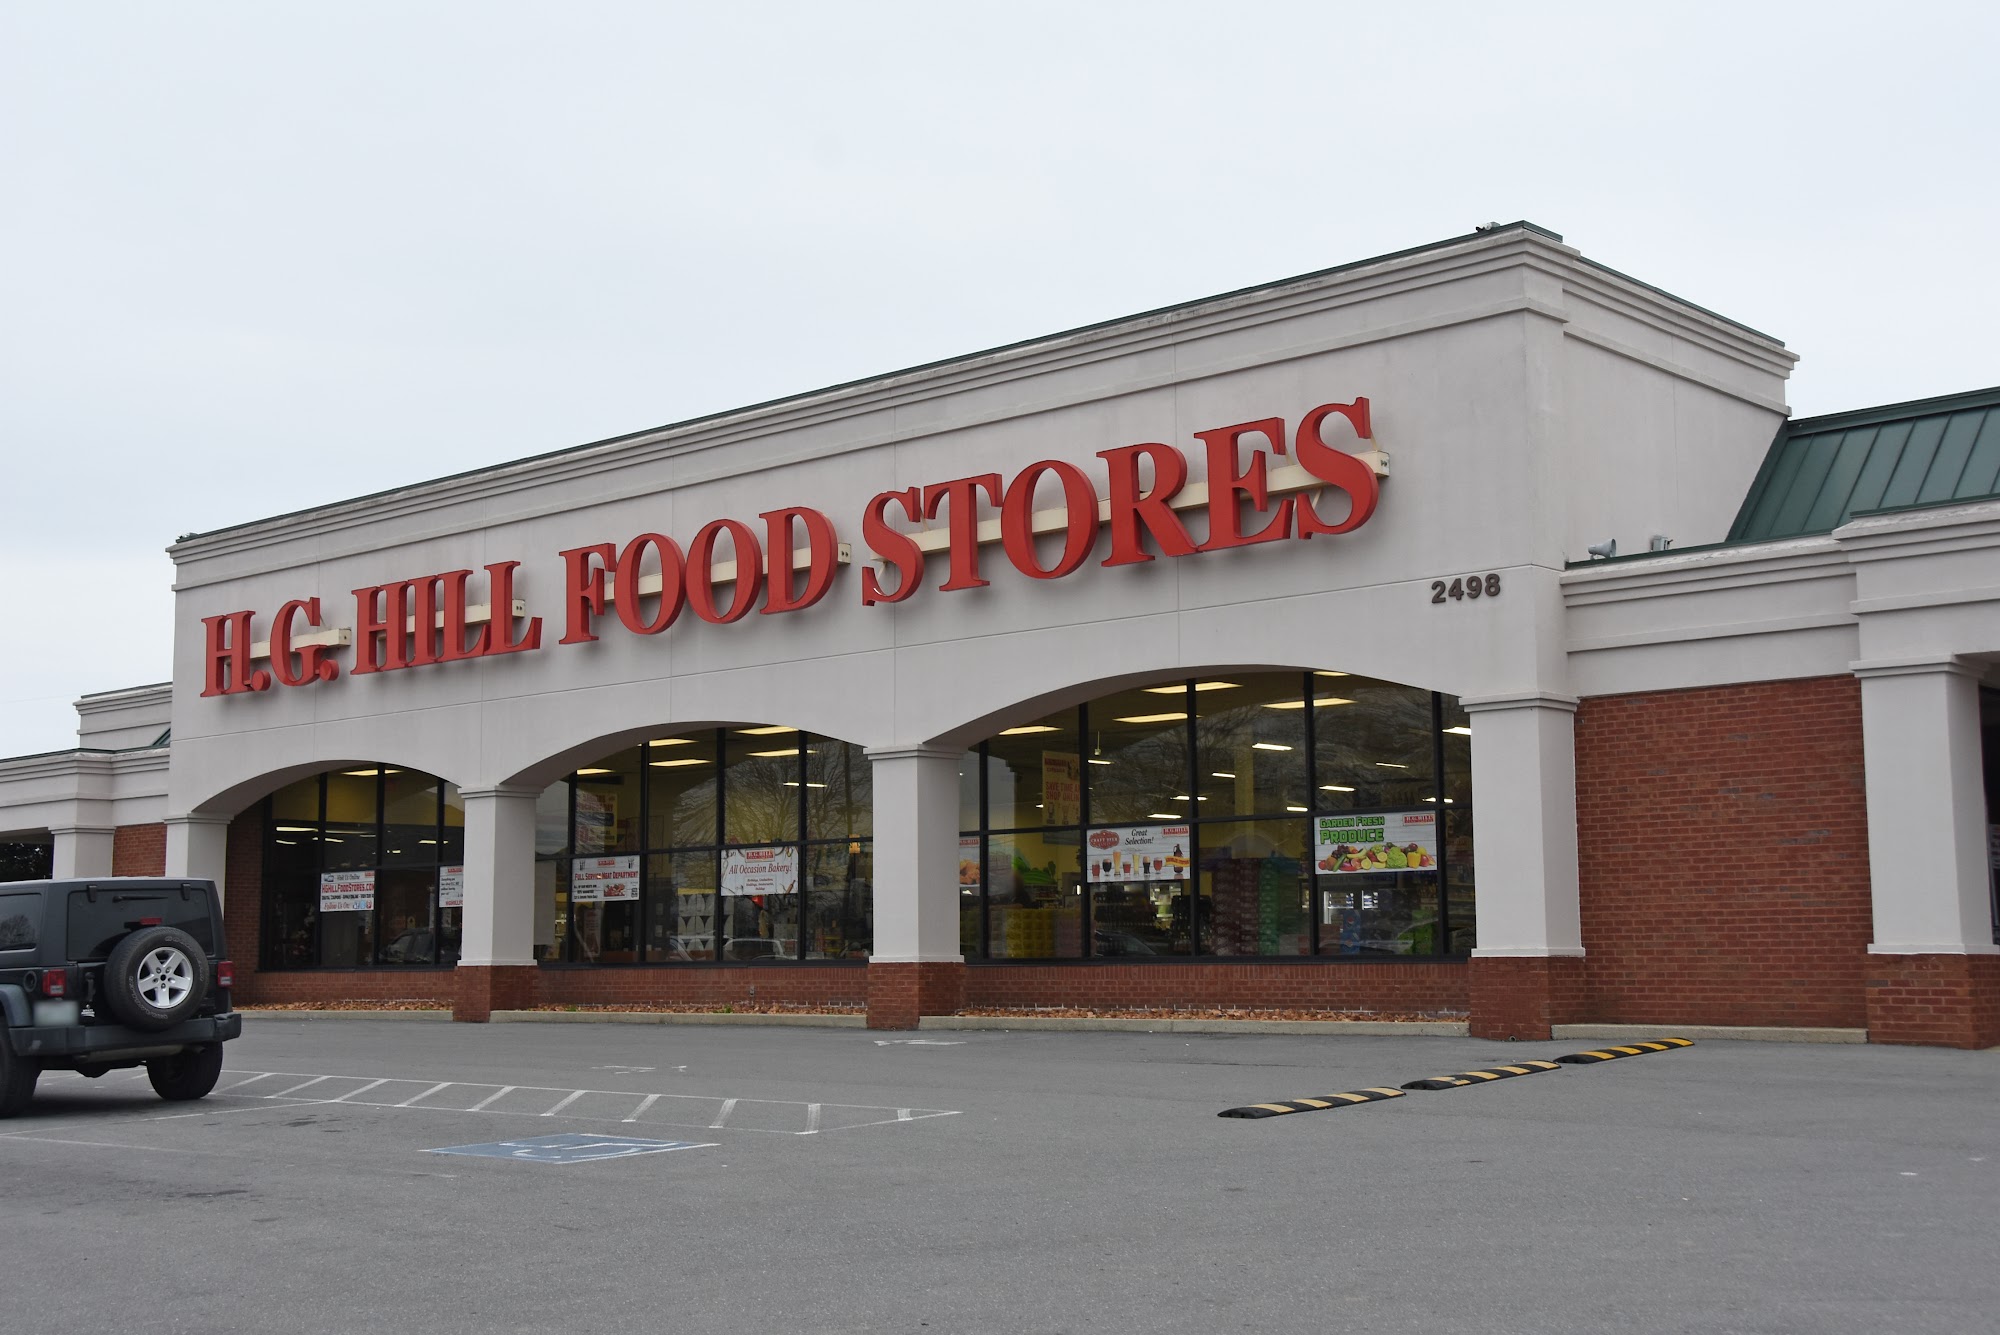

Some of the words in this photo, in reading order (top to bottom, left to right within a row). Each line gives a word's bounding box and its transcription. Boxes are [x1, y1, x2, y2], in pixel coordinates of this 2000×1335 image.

[200, 597, 339, 697] H.G.
[350, 561, 542, 675] HILL
[559, 506, 837, 645] FOOD
[862, 397, 1379, 607] STORES
[1431, 573, 1501, 605] 2498
[1320, 818, 1354, 828] GARDEN
[1356, 816, 1385, 826] FRESH
[1131, 828, 1148, 837] Great
[1320, 828, 1384, 844] PRODUCE
[1125, 836, 1155, 846] Selection!
[729, 864, 738, 874] All
[740, 864, 766, 874] Occasion
[768, 863, 792, 874] Bakery!
[613, 871, 638, 879] DEPARTMENT
